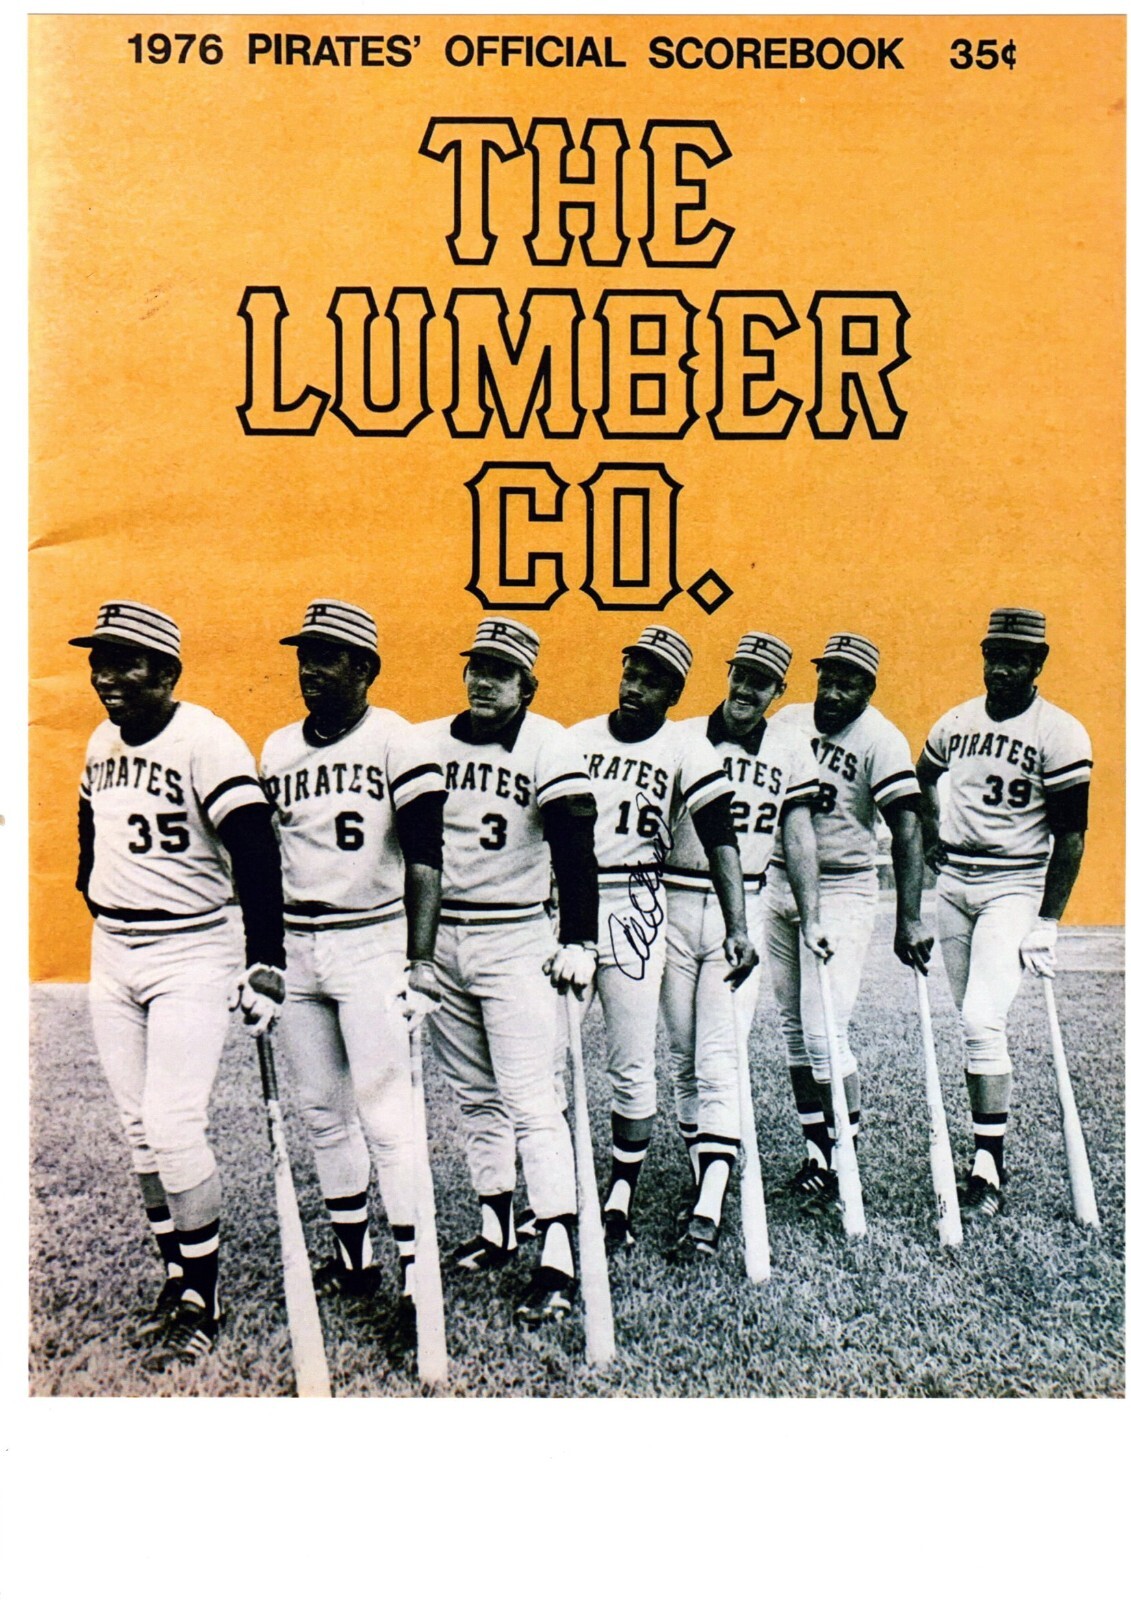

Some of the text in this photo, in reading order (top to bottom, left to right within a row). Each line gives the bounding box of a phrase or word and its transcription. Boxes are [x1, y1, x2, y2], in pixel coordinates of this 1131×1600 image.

[127, 33, 224, 66] 1976
[445, 34, 627, 69] OFFICIAL
[648, 35, 905, 71] SCOREBOOK
[949, 38, 1017, 71] 35¢
[418, 116, 736, 269] THE
[235, 285, 912, 441] LUMBER
[463, 460, 734, 615] CO.
[102, 604, 121, 626] P
[310, 605, 327, 625] P
[650, 629, 668, 646] P
[751, 637, 768, 655] P
[836, 637, 851, 652] P
[949, 732, 1037, 774] PIRATES
[86, 755, 185, 807] PIRATES
[264, 762, 385, 806] PIRATES
[583, 753, 669, 801] RATES
[982, 774, 1033, 809] 39
[127, 811, 191, 854] 35
[334, 811, 364, 852] 6
[479, 812, 508, 851] 3
[615, 800, 663, 838] 16
[729, 800, 778, 835] 22
